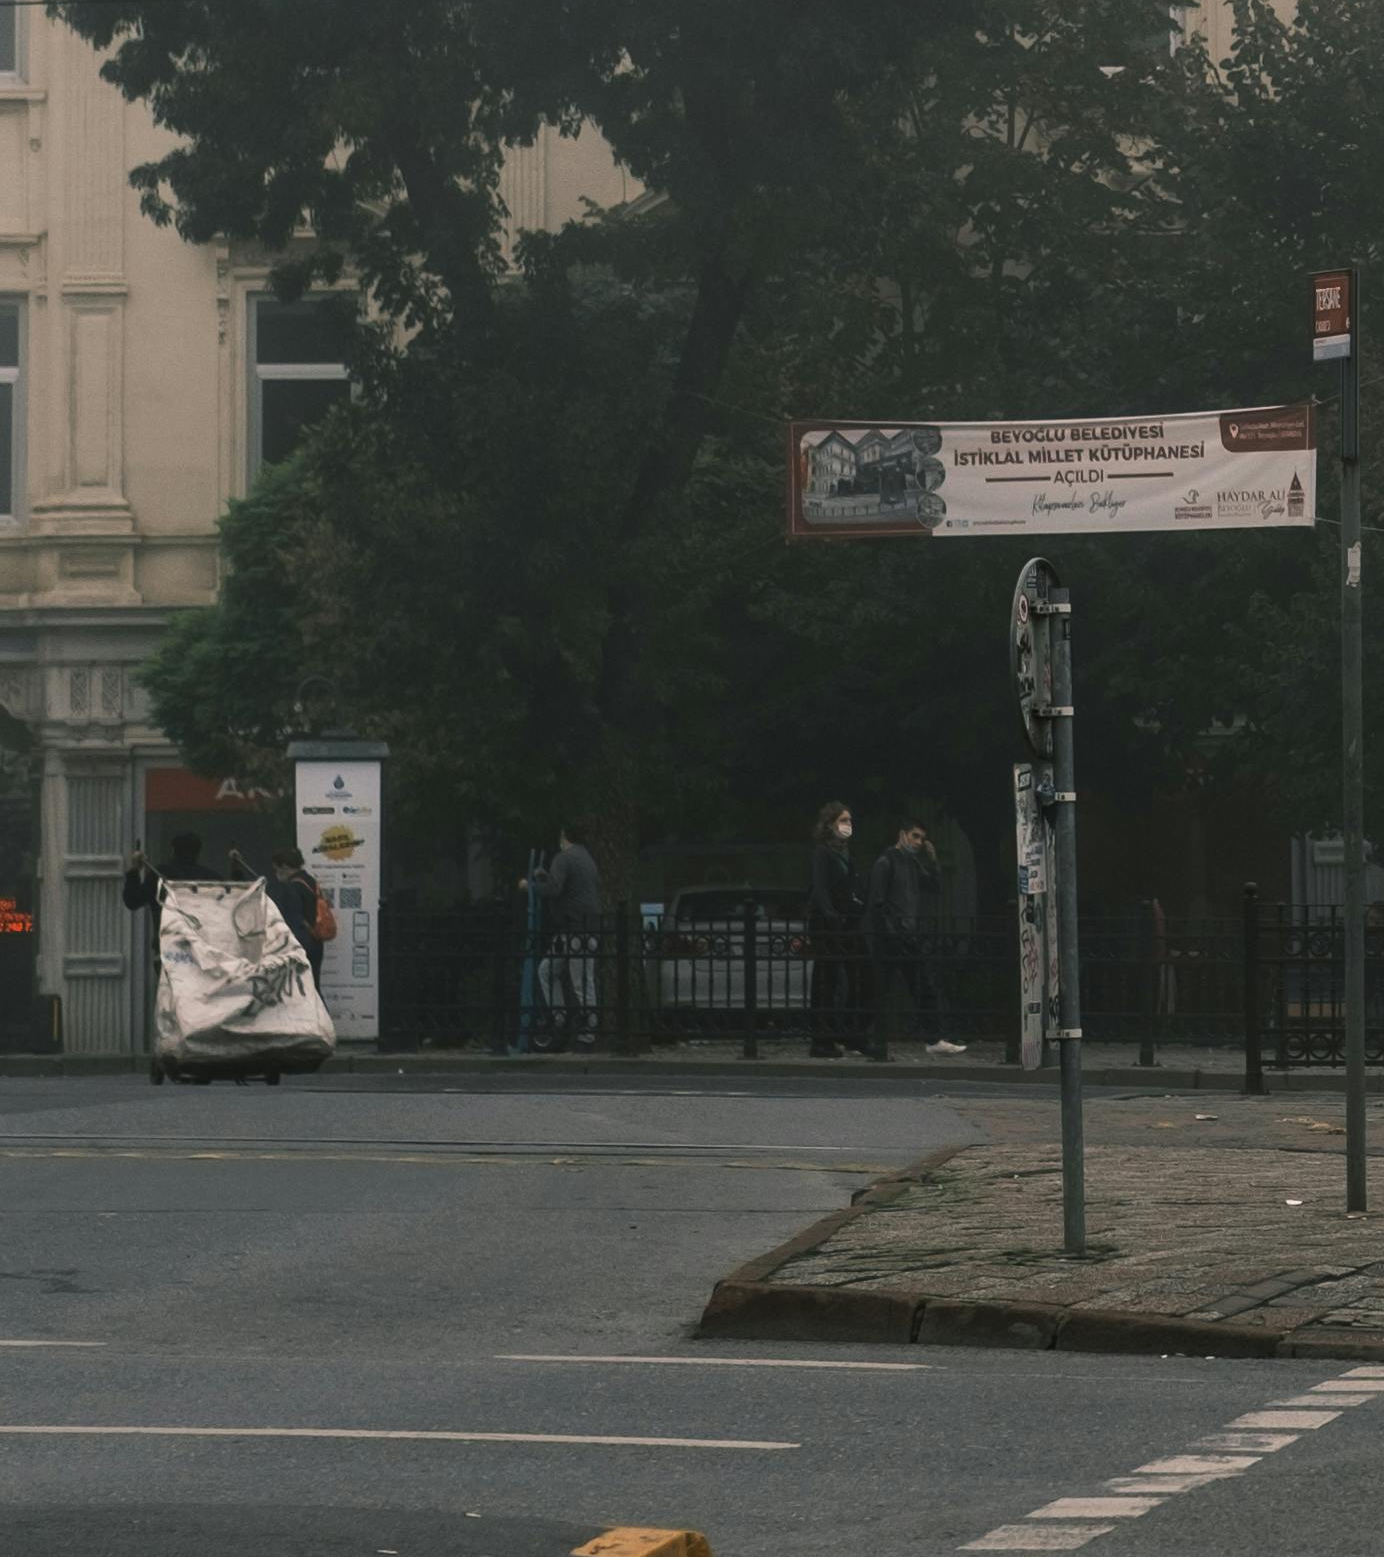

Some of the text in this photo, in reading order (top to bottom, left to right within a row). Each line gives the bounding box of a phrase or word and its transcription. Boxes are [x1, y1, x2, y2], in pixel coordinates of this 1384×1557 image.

[990, 423, 1164, 444] BEYOĞLU BELEDİYESİ
[1028, 446, 1084, 464] MİLLET
[1089, 440, 1205, 463] KÜTÜPHANESİ
[1216, 489, 1267, 503] HAYDAR
